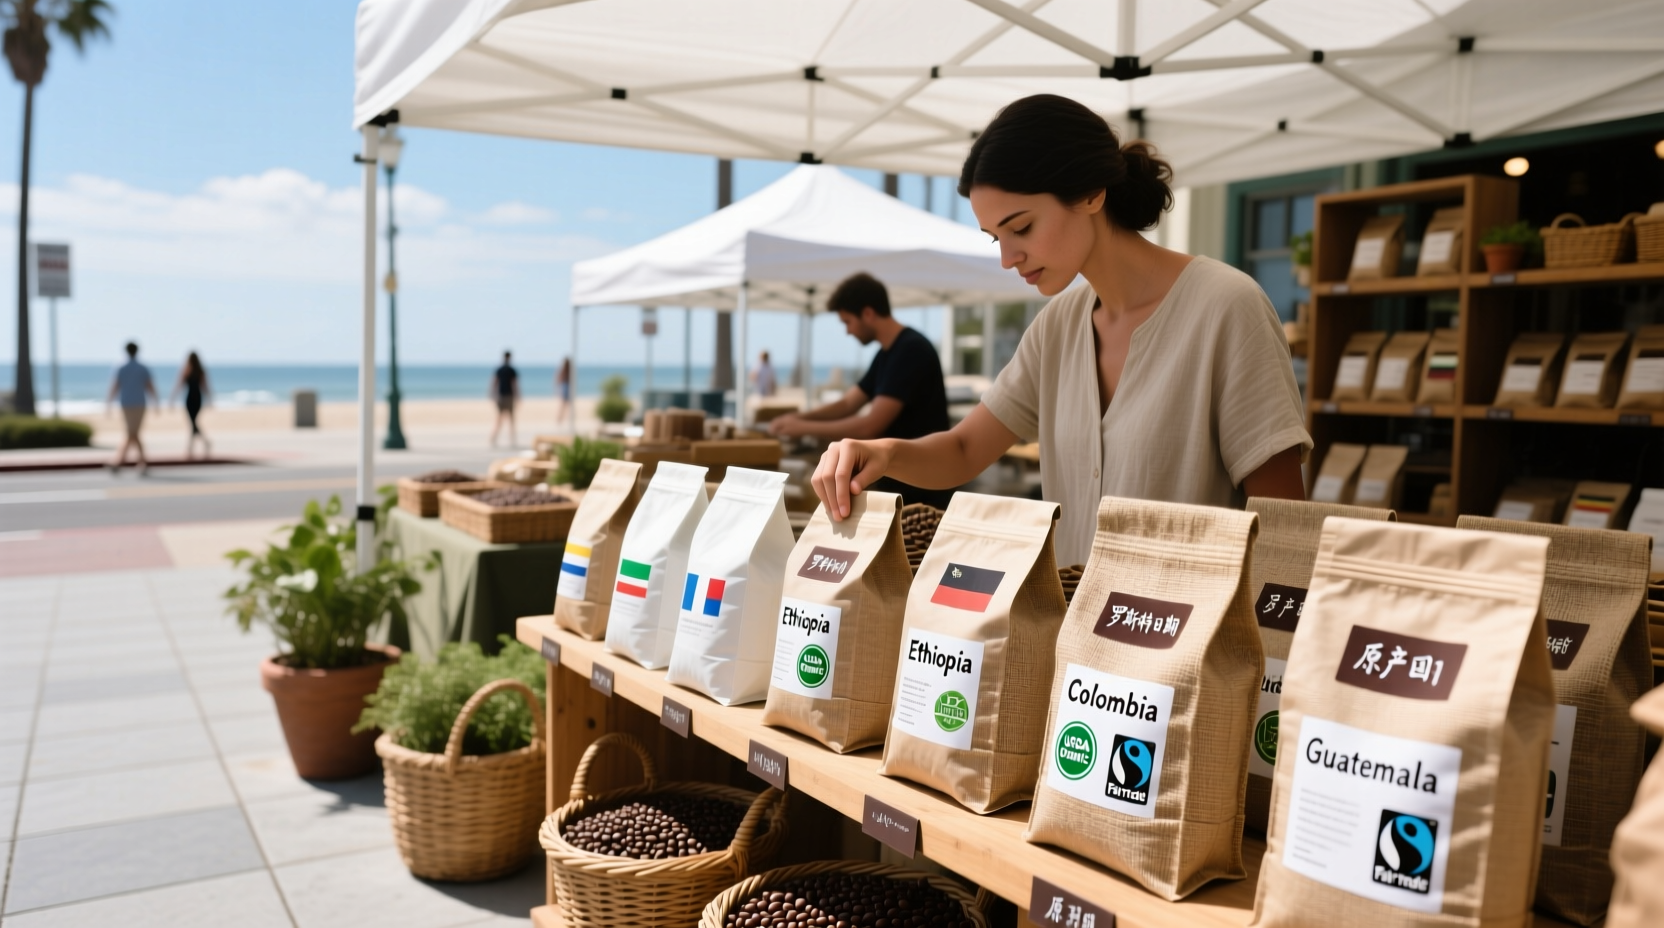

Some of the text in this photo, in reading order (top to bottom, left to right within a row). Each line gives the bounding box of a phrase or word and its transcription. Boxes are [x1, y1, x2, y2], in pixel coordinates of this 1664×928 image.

[782, 606, 830, 636] Ethiopia
[908, 639, 972, 677] Ethiopia
[1068, 678, 1158, 722] Colombia
[1306, 737, 1438, 794] Guatemala
